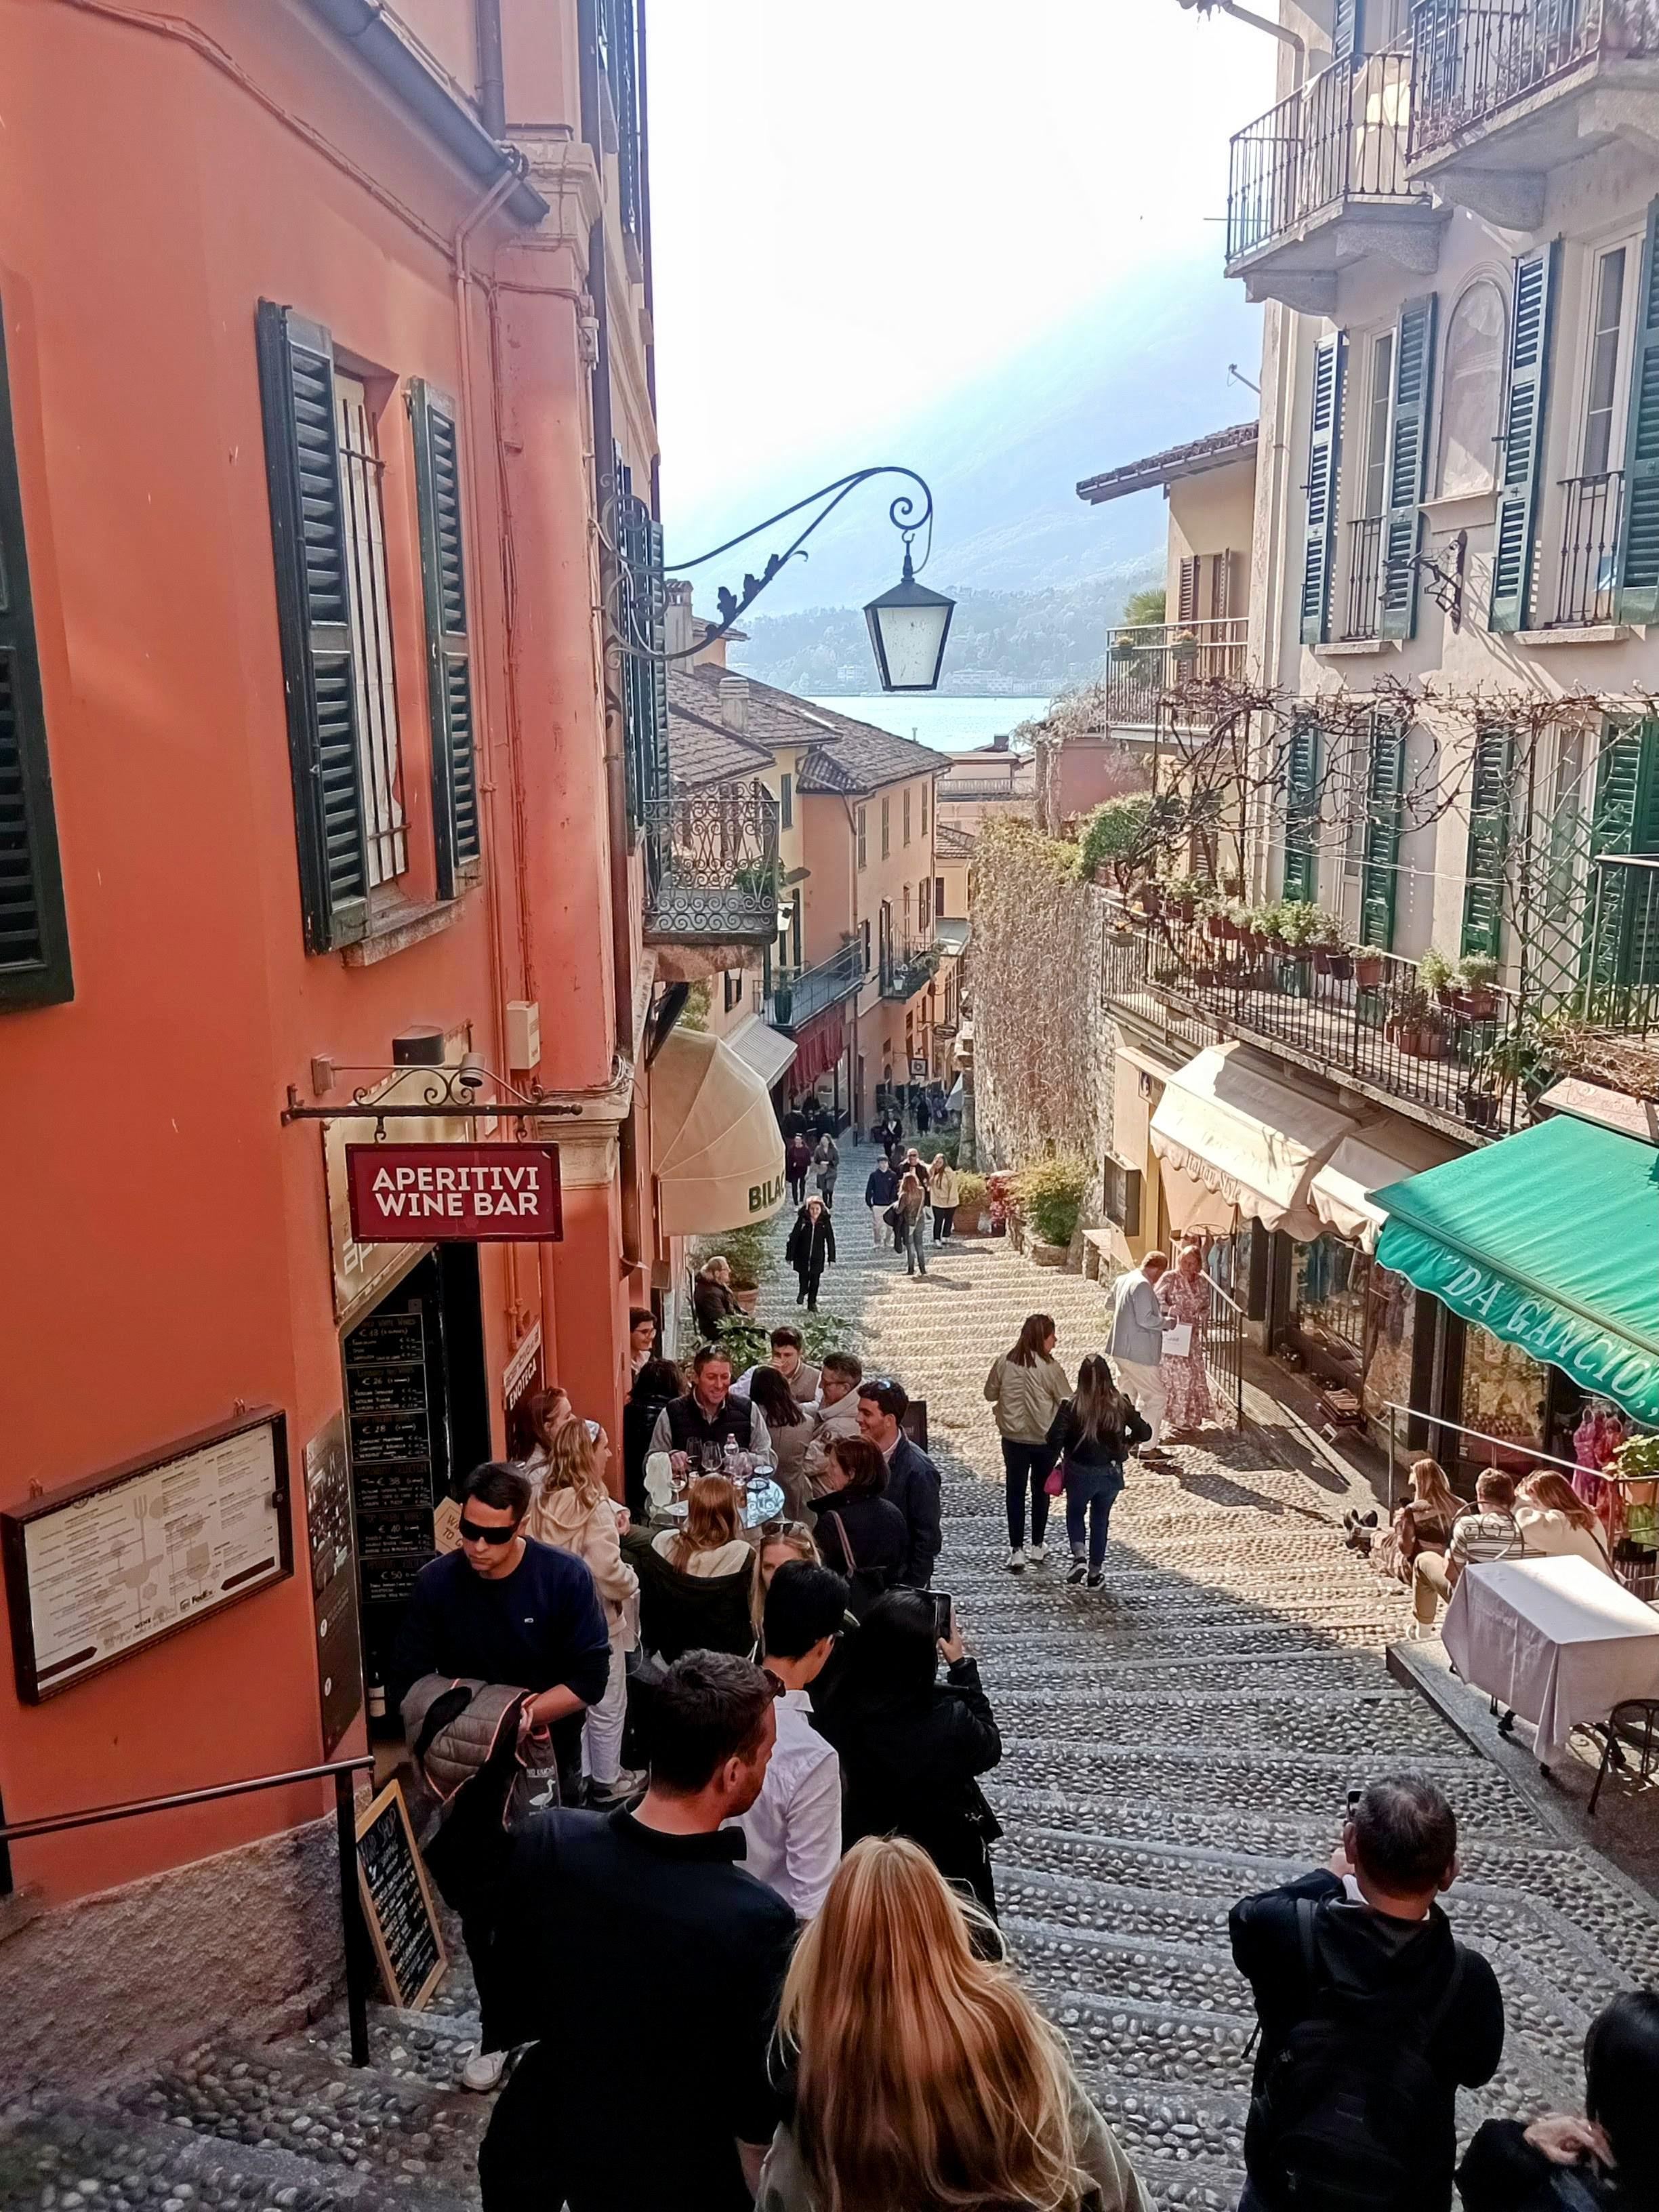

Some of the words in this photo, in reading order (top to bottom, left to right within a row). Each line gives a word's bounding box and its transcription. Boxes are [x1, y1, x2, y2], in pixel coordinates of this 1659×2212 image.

[372, 1167, 540, 1191] APERITIVI
[1186, 1151, 1216, 1185] Italian
[1219, 1171, 1242, 1201] Style
[375, 1193, 464, 1216] WINE
[474, 1192, 539, 1216] BAR
[510, 1357, 537, 1411] ENOTECA
[443, 1527, 454, 1540] TO
